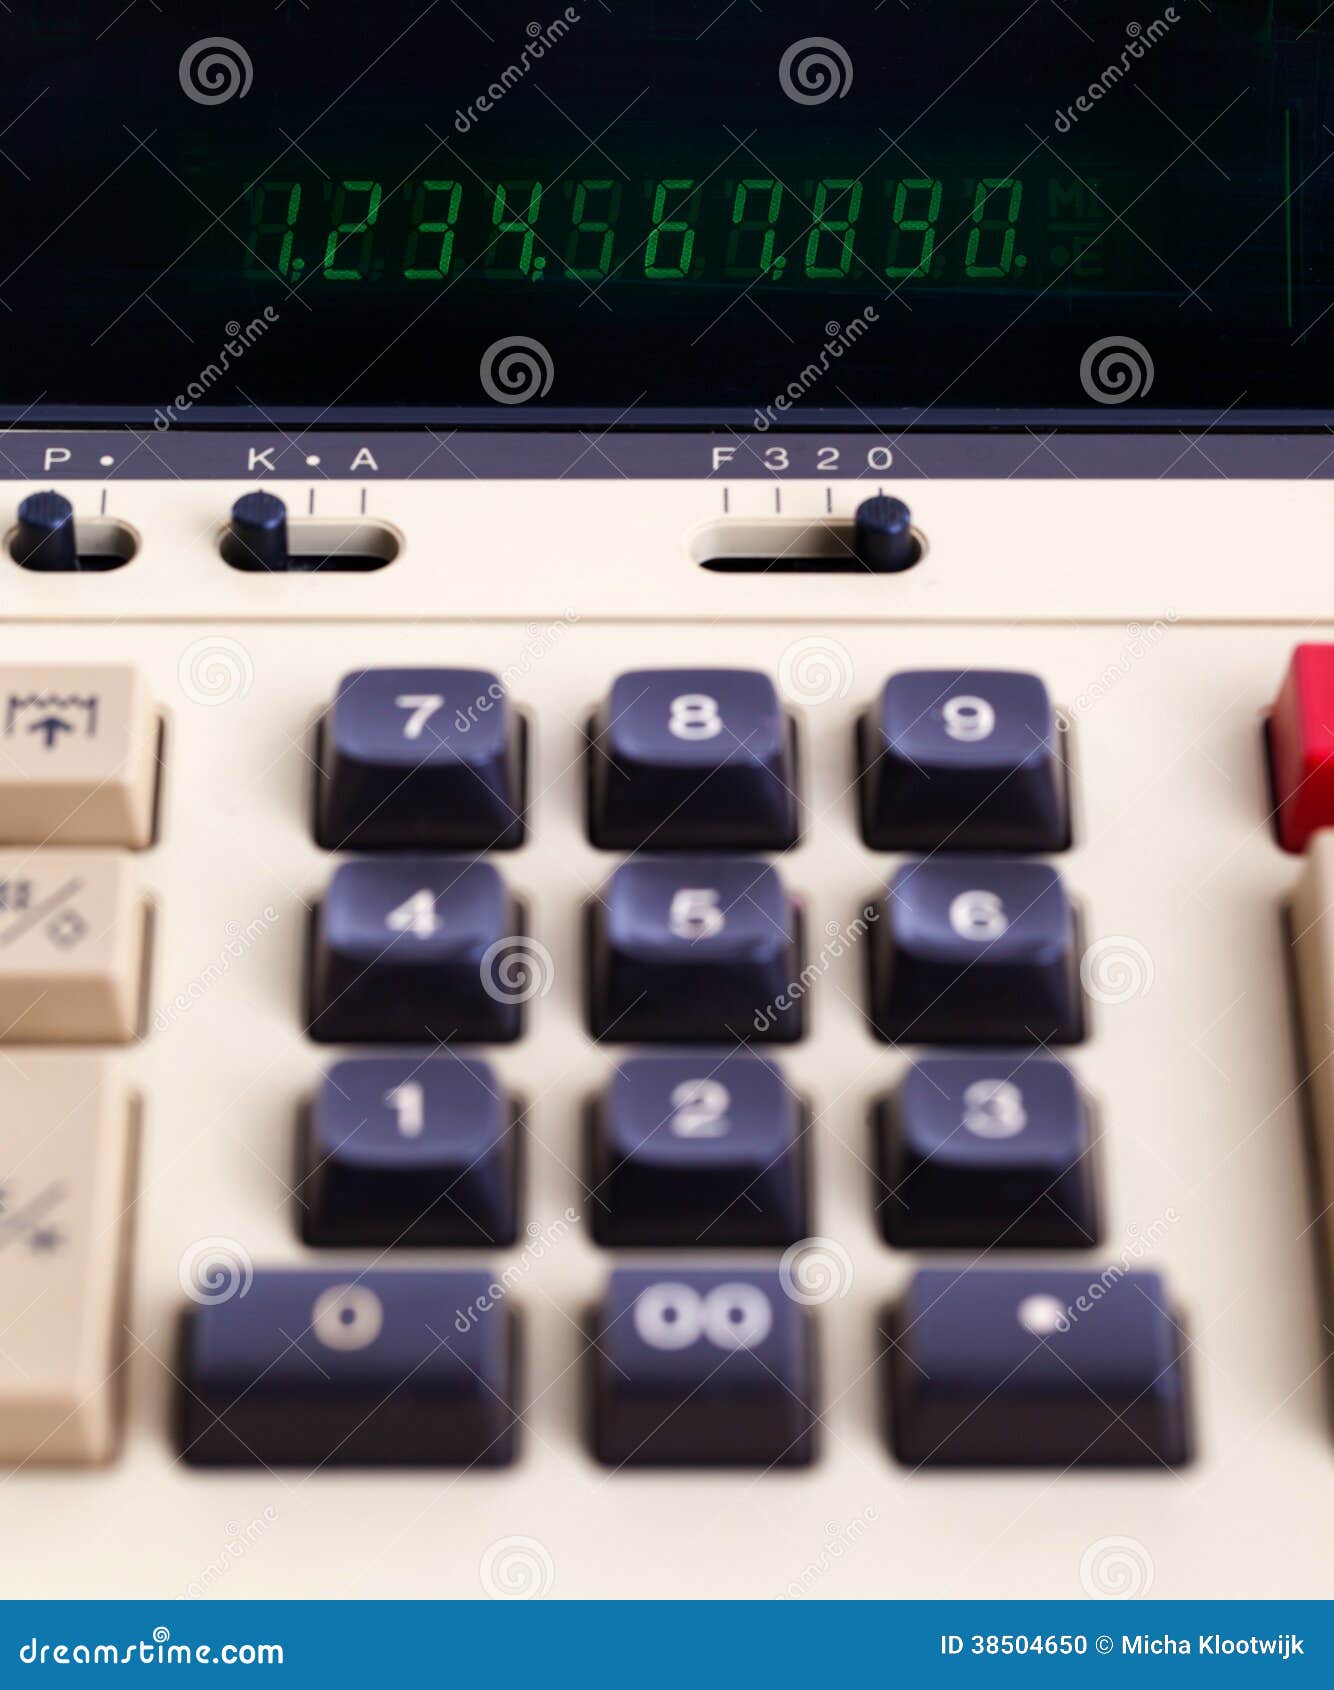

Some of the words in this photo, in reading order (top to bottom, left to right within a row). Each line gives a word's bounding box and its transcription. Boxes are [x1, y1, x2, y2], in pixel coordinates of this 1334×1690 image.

[44, 448, 72, 471] P
[248, 448, 276, 471] K
[350, 448, 379, 471] A
[711, 447, 737, 471] F
[764, 447, 790, 471] 3
[816, 447, 840, 471] 2
[396, 695, 444, 739] 7
[669, 693, 723, 741] 8
[942, 695, 996, 742] 9
[385, 889, 441, 939] 4
[669, 888, 725, 940] 5
[949, 889, 1008, 942] 6
[384, 1080, 425, 1138] 1
[669, 1078, 731, 1139] 2
[962, 1078, 1028, 1139] 3
[312, 1283, 384, 1352] 0
[633, 1281, 773, 1351] 00
